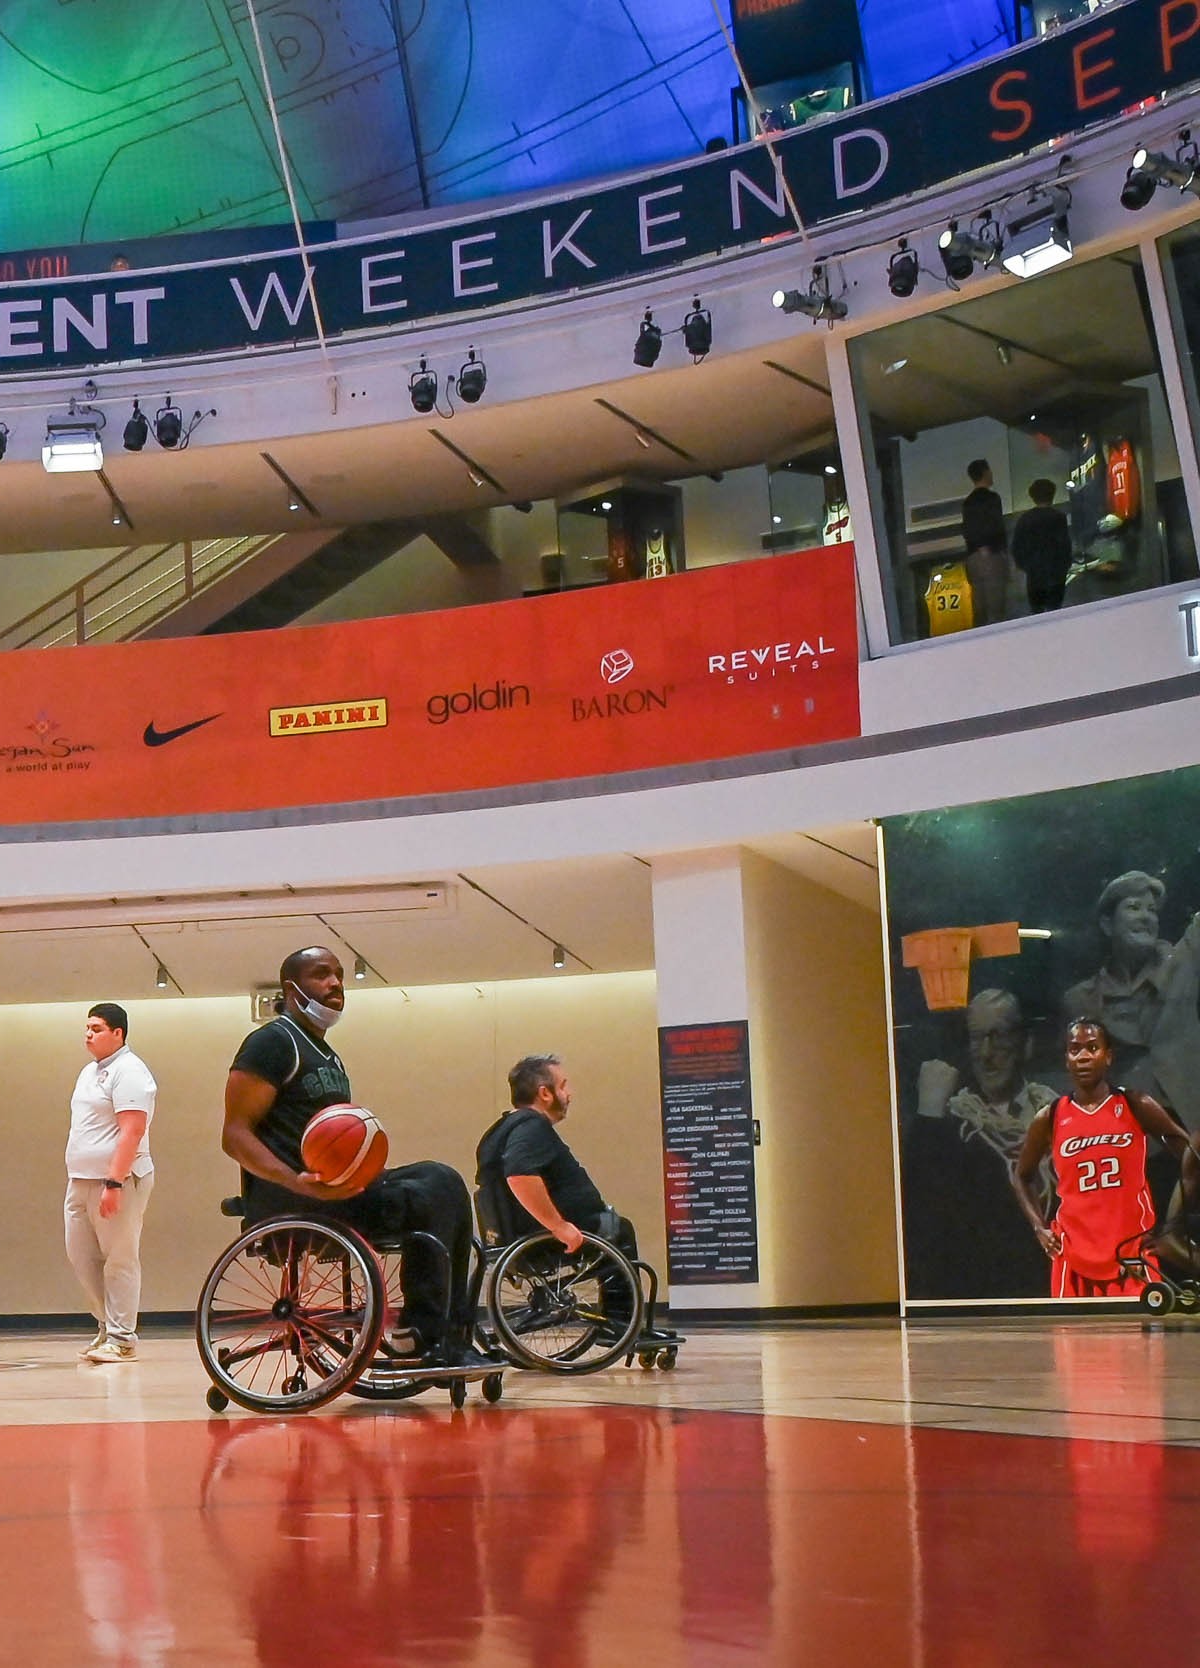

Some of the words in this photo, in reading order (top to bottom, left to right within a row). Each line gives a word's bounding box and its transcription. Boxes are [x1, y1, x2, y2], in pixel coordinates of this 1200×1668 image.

[229, 128, 890, 332] WEEKEND
[989, 0, 1200, 142] SEP
[937, 594, 961, 612] 32
[708, 636, 835, 673] REVEAL
[727, 660, 820, 685] SUITS
[427, 680, 531, 725] goldin
[277, 704, 380, 729] PANINI
[50, 737, 96, 758] Sun
[16, 762, 48, 773] world
[51, 762, 63, 772] at
[65, 760, 91, 774] play
[1060, 1132, 1134, 1158] COMETS
[1076, 1157, 1121, 1192] 22
